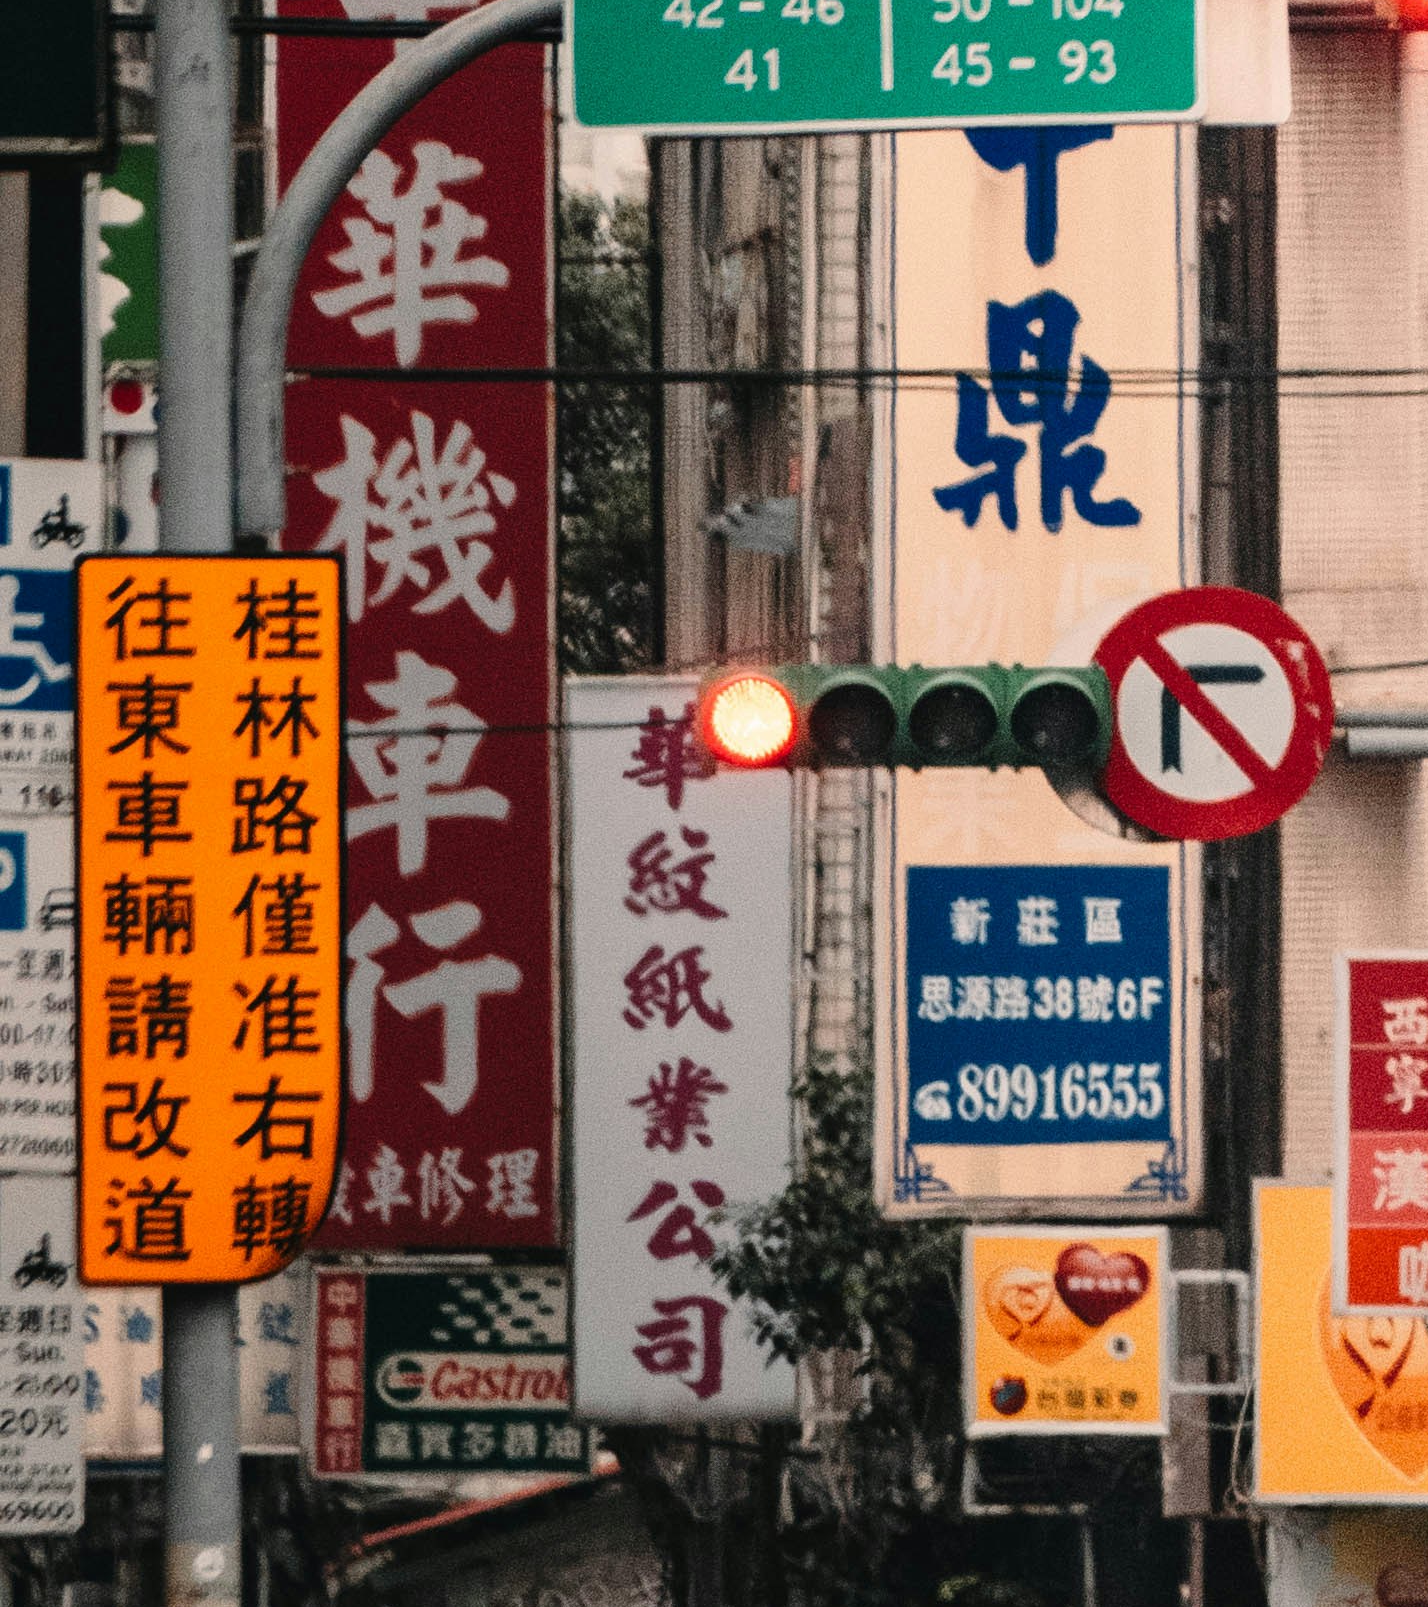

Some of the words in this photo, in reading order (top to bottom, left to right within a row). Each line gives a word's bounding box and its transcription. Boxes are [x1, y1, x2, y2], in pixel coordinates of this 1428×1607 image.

[725, 48, 779, 91] 41
[104, 577, 194, 1262] 往東車輛請改道
[232, 578, 324, 1262] 桂林路僅准右轉
[951, 897, 1122, 945] 新莊區
[918, 976, 1162, 1021] 思源路38號6F
[958, 1063, 1163, 1120] 89916555
